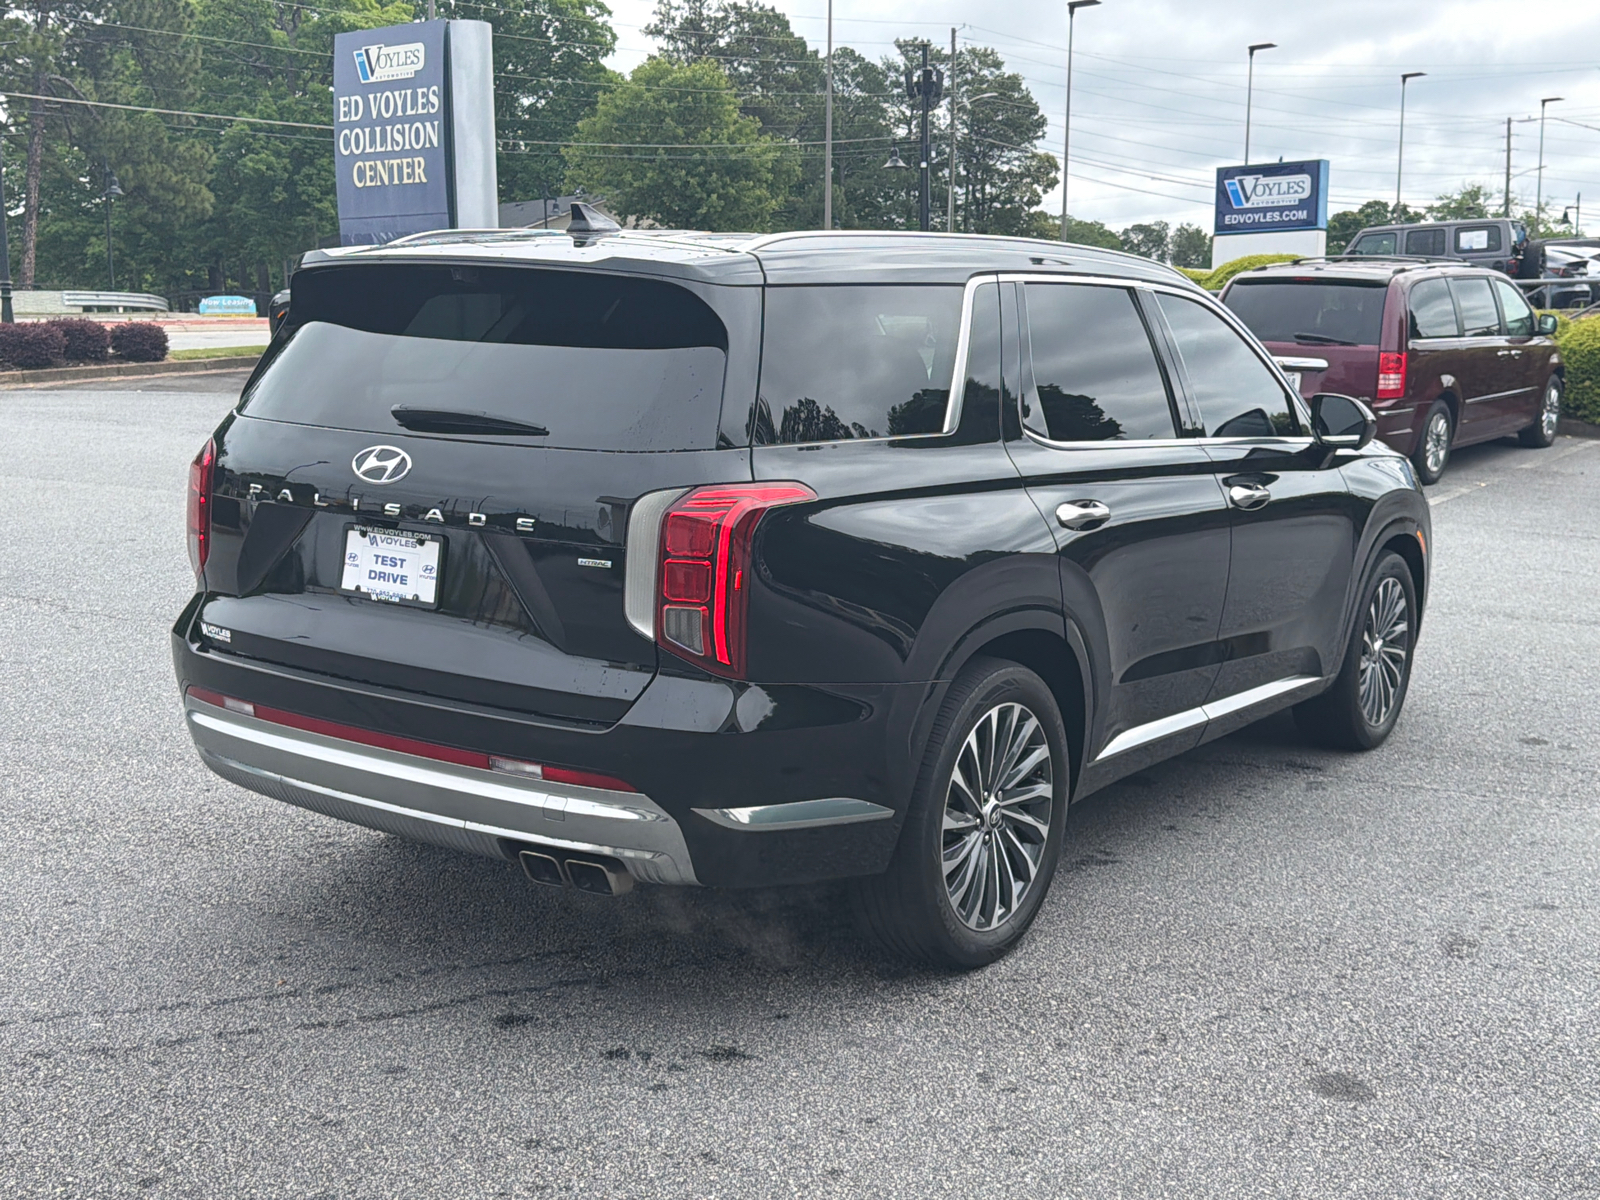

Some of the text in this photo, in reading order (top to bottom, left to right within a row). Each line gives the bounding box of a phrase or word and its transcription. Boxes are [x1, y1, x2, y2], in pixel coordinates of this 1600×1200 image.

[375, 71, 413, 80] AUTOMOTIVE
[338, 86, 439, 122] ED VOYLES
[339, 121, 439, 156] COLLISION
[353, 157, 427, 188] CENTER
[1251, 198, 1297, 206] AUTOMOTIVE
[1224, 210, 1307, 224] EDVOYLES.COM
[201, 298, 220, 306] Now
[222, 298, 255, 307] Leasing
[249, 483, 536, 532] PALISADE
[379, 535, 418, 549] VOYLES
[373, 554, 406, 569] TEST
[579, 559, 610, 567] HTRAC
[368, 569, 408, 586] DRIVE
